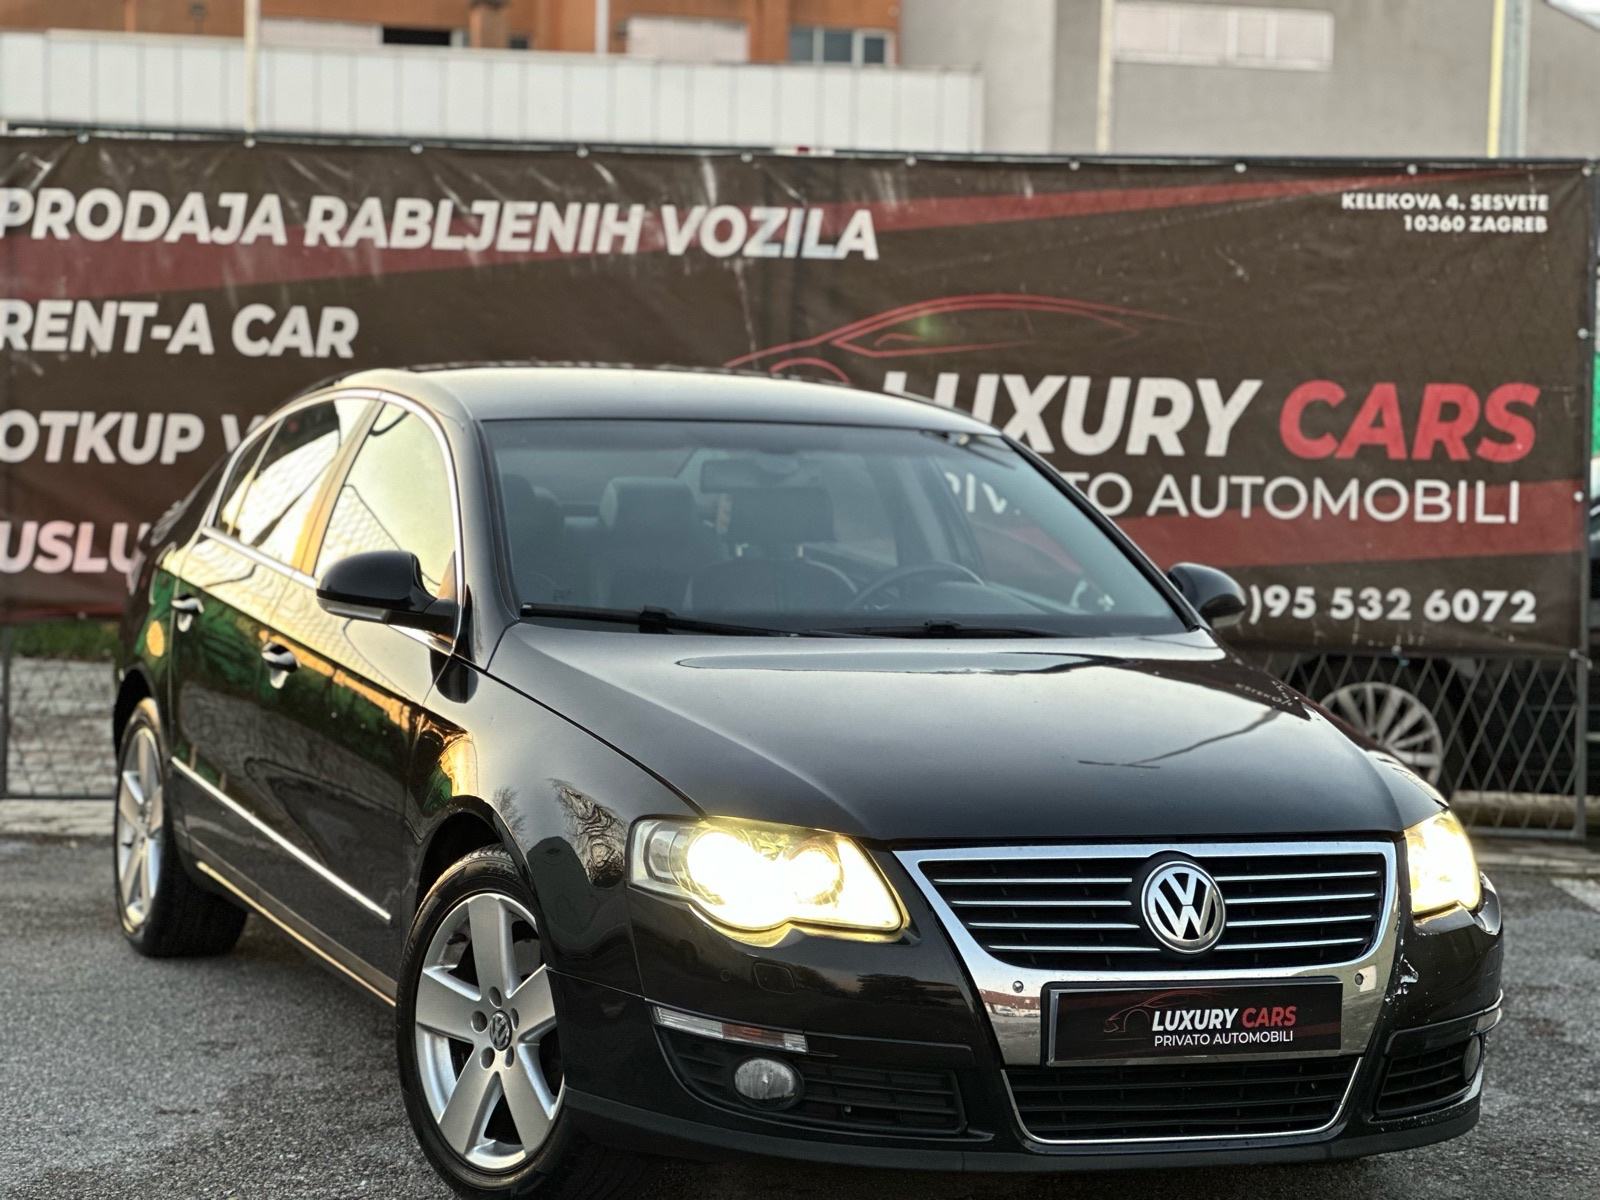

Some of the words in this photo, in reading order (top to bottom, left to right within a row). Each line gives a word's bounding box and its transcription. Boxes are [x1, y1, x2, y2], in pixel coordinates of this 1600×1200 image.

[1341, 192, 1442, 210] KELEKOVA
[1470, 194, 1549, 211] SESVETE
[0, 188, 287, 246] PRODAJA
[304, 196, 645, 254] RABLJENIH
[661, 204, 879, 260] VOZILA
[1403, 214, 1466, 232] 10360
[1469, 215, 1548, 233] ZAGREB
[0, 299, 214, 355] RENT-A
[232, 304, 359, 358] CAR
[0, 409, 205, 465] OTKUP
[1279, 379, 1541, 463] CARS
[1146, 474, 1520, 524] AUTOMOBILI
[1330, 587, 1411, 621] 532
[1423, 589, 1537, 623] 6072
[1152, 1008, 1239, 1032] LUXURY
[1242, 1006, 1297, 1029] CARS
[1154, 1033, 1210, 1047] PRIVATO
[1213, 1030, 1294, 1045] AUTOMOBILI
